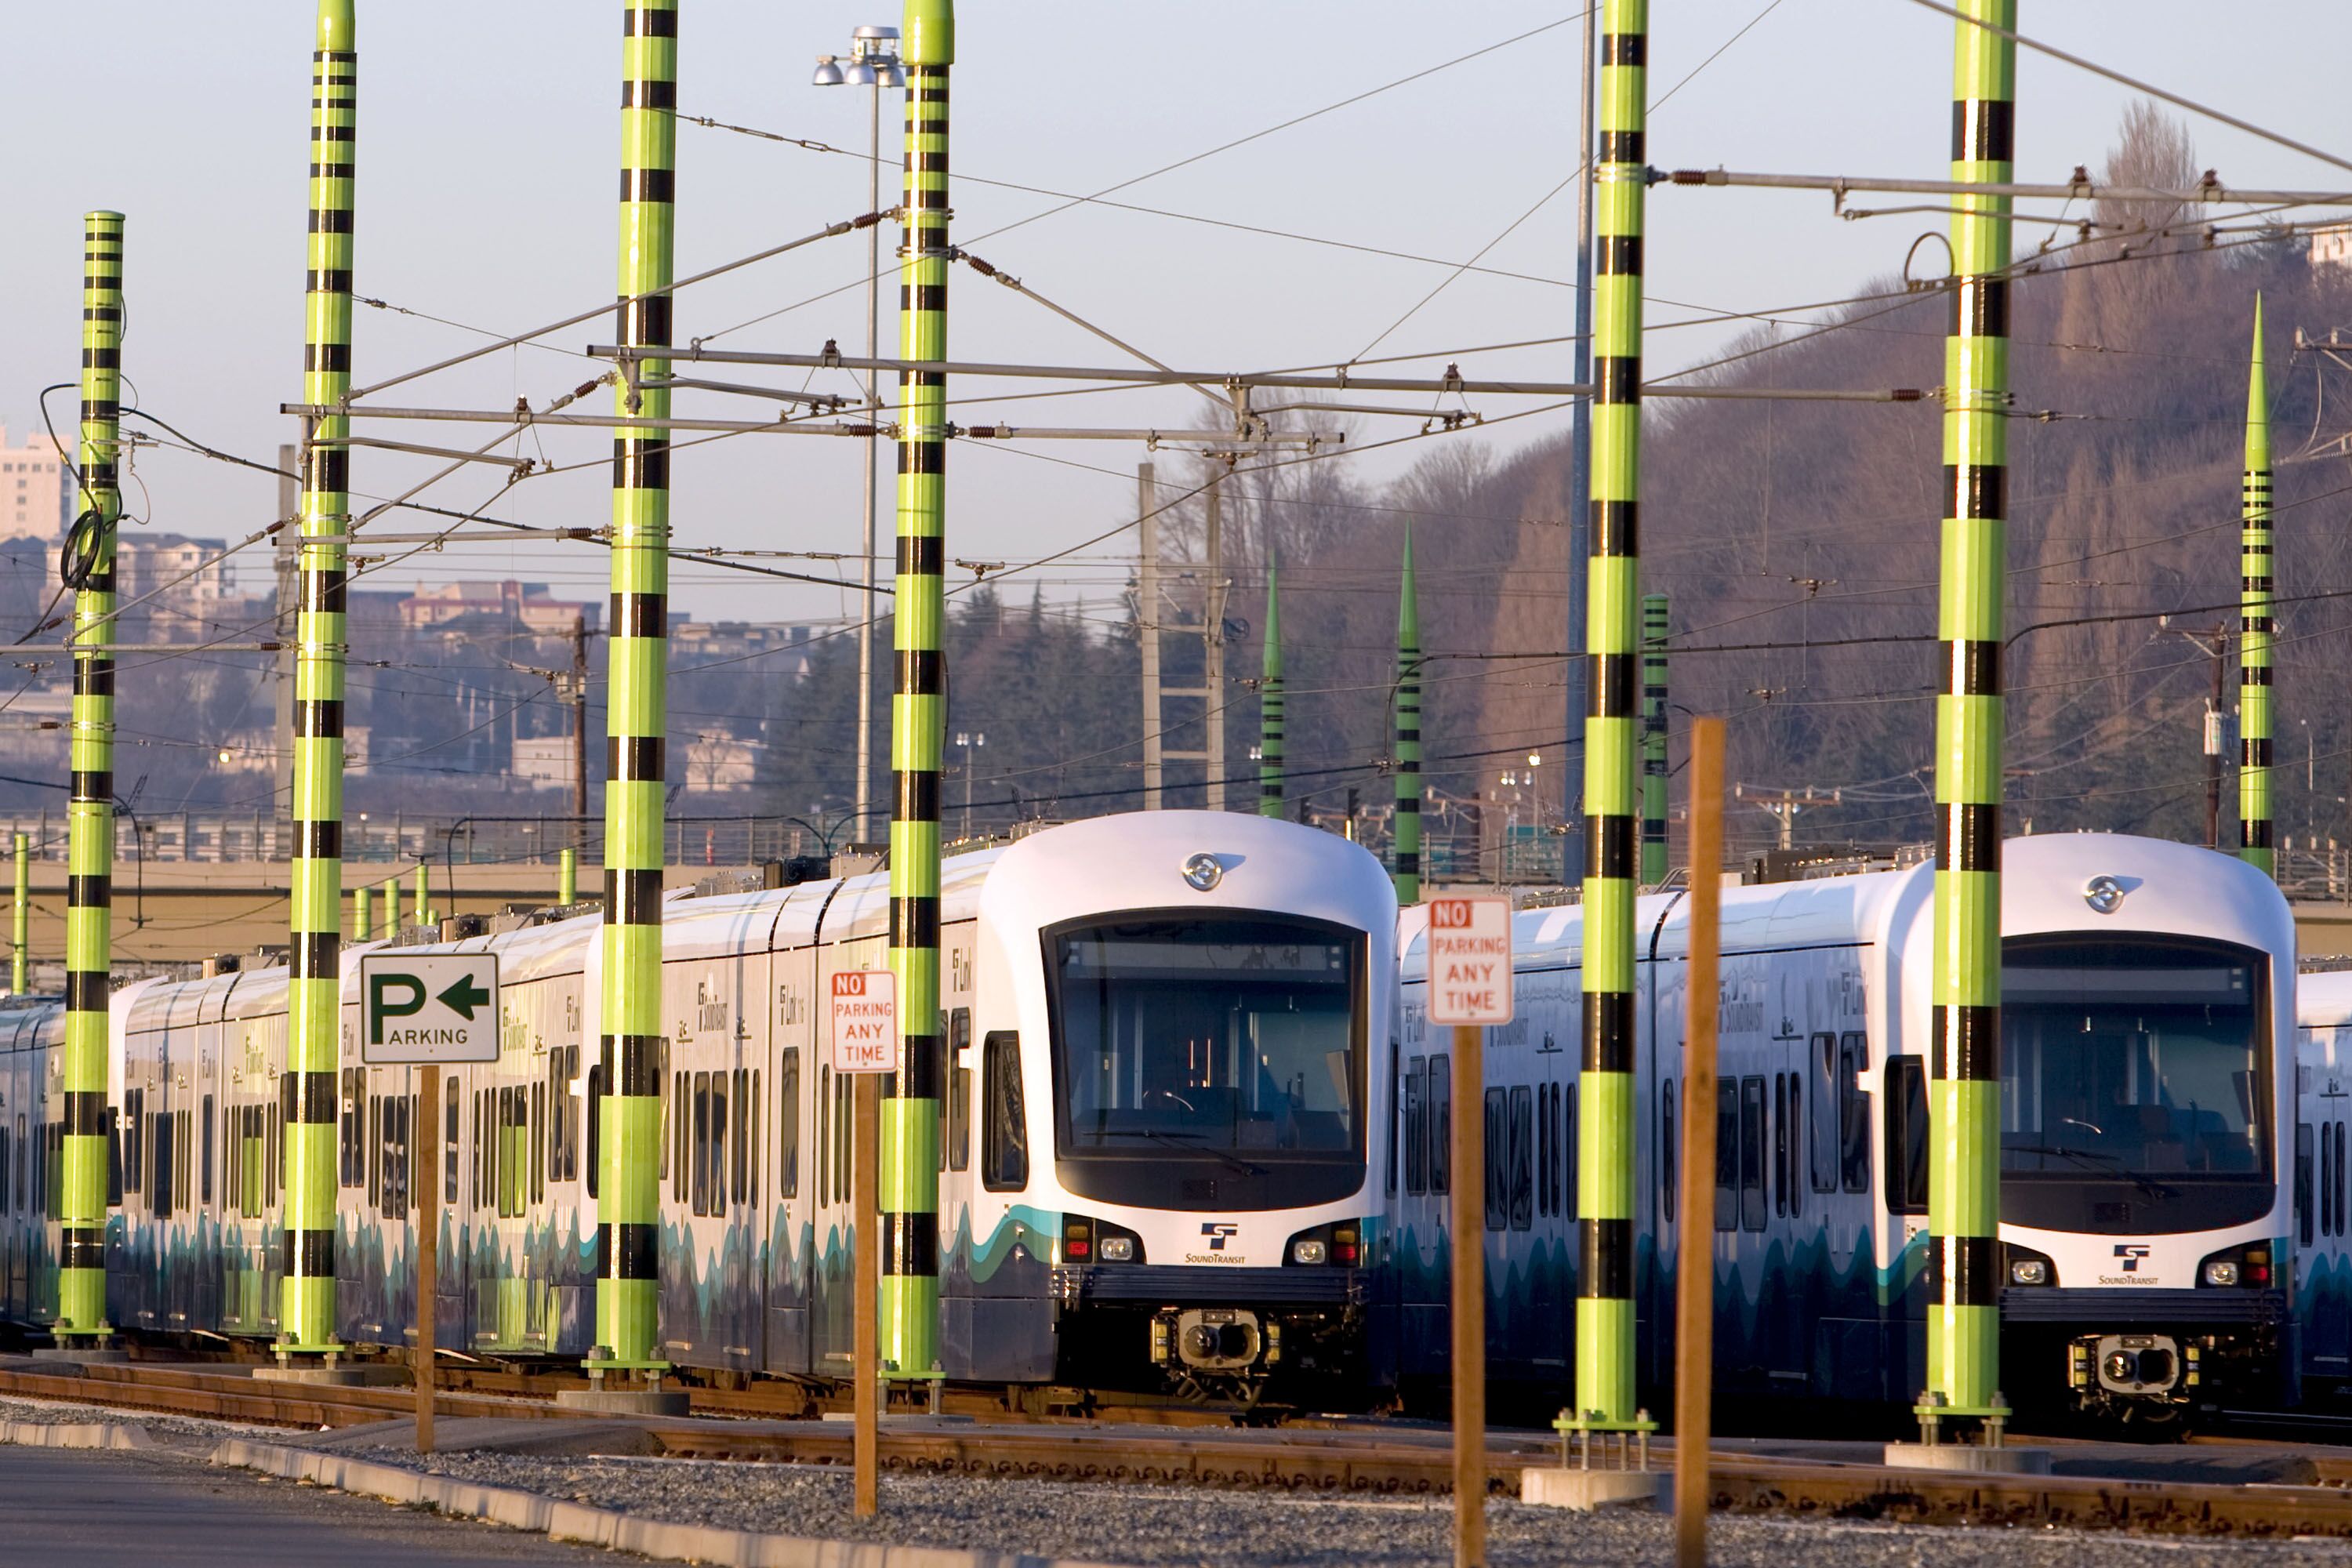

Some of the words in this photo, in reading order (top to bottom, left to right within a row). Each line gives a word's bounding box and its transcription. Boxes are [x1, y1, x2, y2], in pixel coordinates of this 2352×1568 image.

[1436, 902, 1467, 927] NO
[1436, 937, 1506, 954] PARKING
[1446, 964, 1494, 983] ANY
[836, 975, 862, 994] NO
[836, 1002, 892, 1018] PARKING
[1446, 991, 1495, 1011] TIME
[845, 1024, 884, 1040] ANY
[845, 1046, 884, 1061] TIME
